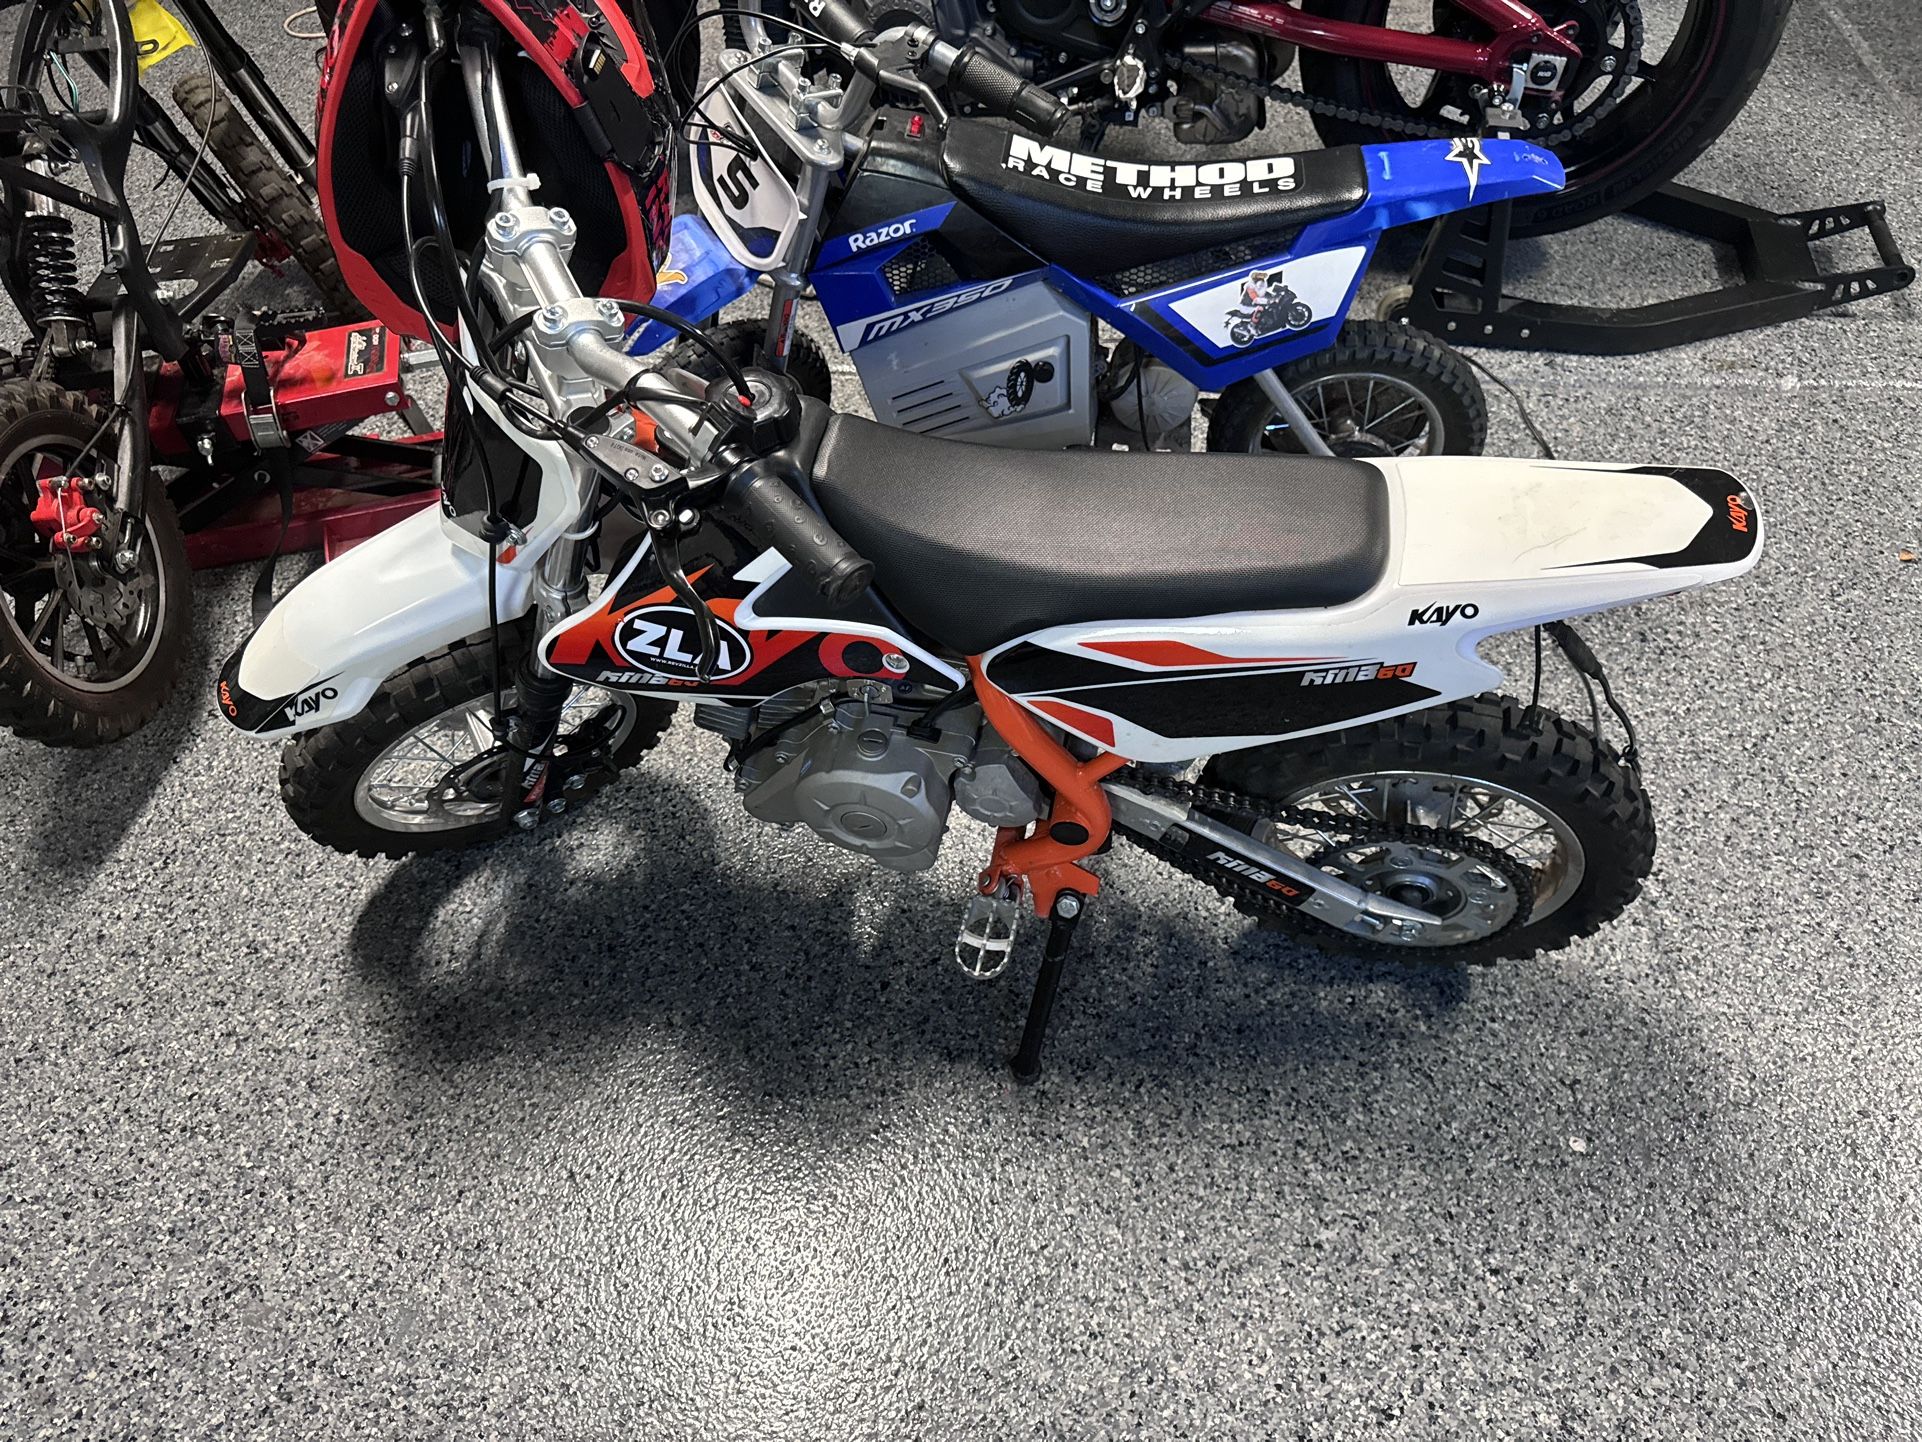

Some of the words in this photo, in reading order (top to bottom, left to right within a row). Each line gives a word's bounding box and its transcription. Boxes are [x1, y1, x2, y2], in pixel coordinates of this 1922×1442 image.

[1007, 156, 1103, 193] RACE
[1128, 177, 1296, 200] WHEELS
[1009, 134, 1296, 187] METHOD
[848, 219, 916, 252] Razor
[866, 278, 1014, 342] MX350
[1727, 495, 1748, 533] KAYO
[1408, 601, 1479, 627] KAYO
[220, 680, 237, 717] KAYO
[284, 687, 339, 722] KAYO
